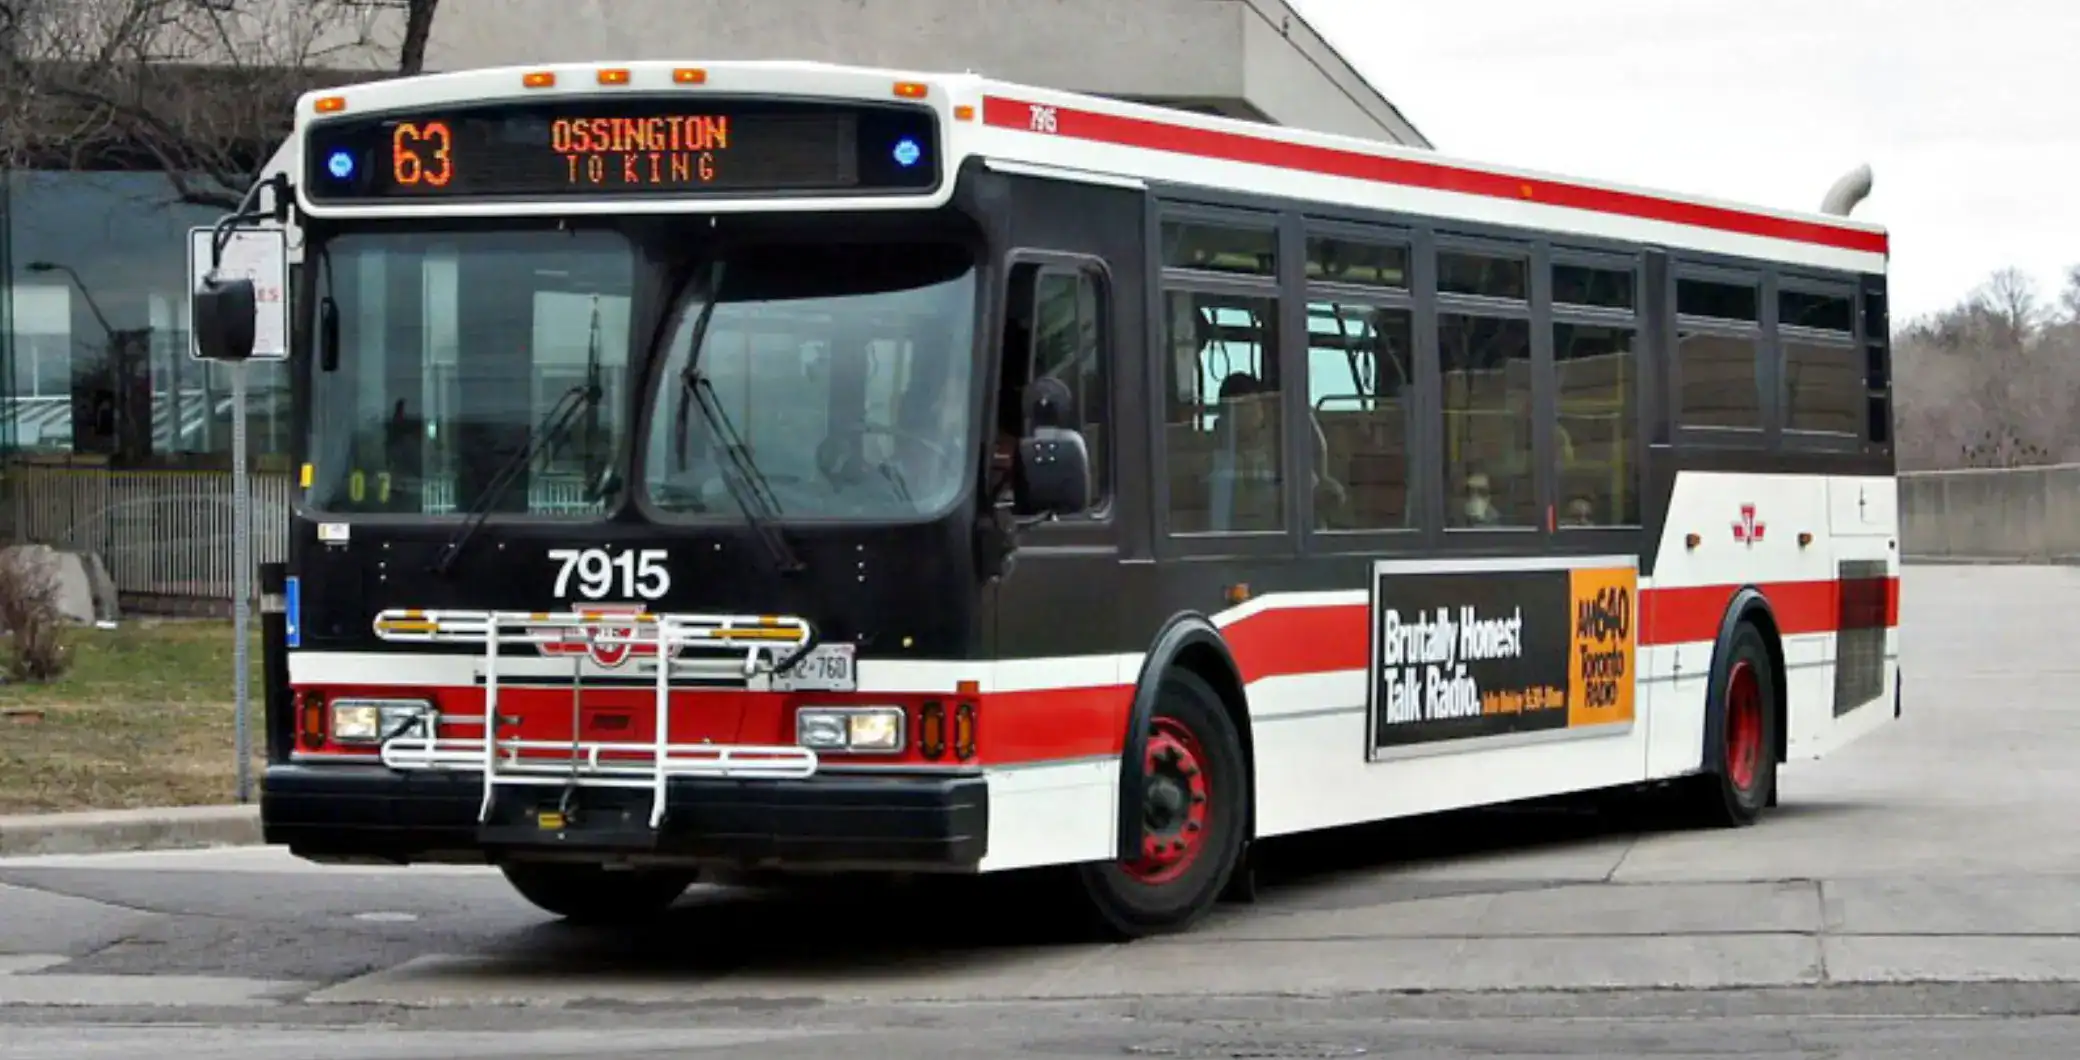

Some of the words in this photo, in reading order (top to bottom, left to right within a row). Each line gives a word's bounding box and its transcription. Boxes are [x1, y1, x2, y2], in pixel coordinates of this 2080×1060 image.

[392, 121, 453, 186] 63
[551, 115, 727, 153] OSSINGTON
[567, 154, 603, 183] TO
[624, 151, 716, 184] KING
[548, 549, 671, 599] 7915
[1384, 607, 1459, 672] Brutally
[1460, 604, 1522, 660] Honest
[1580, 643, 1625, 679] Toronto
[1384, 666, 1422, 724] Talk
[1426, 663, 1481, 720] Radio.
